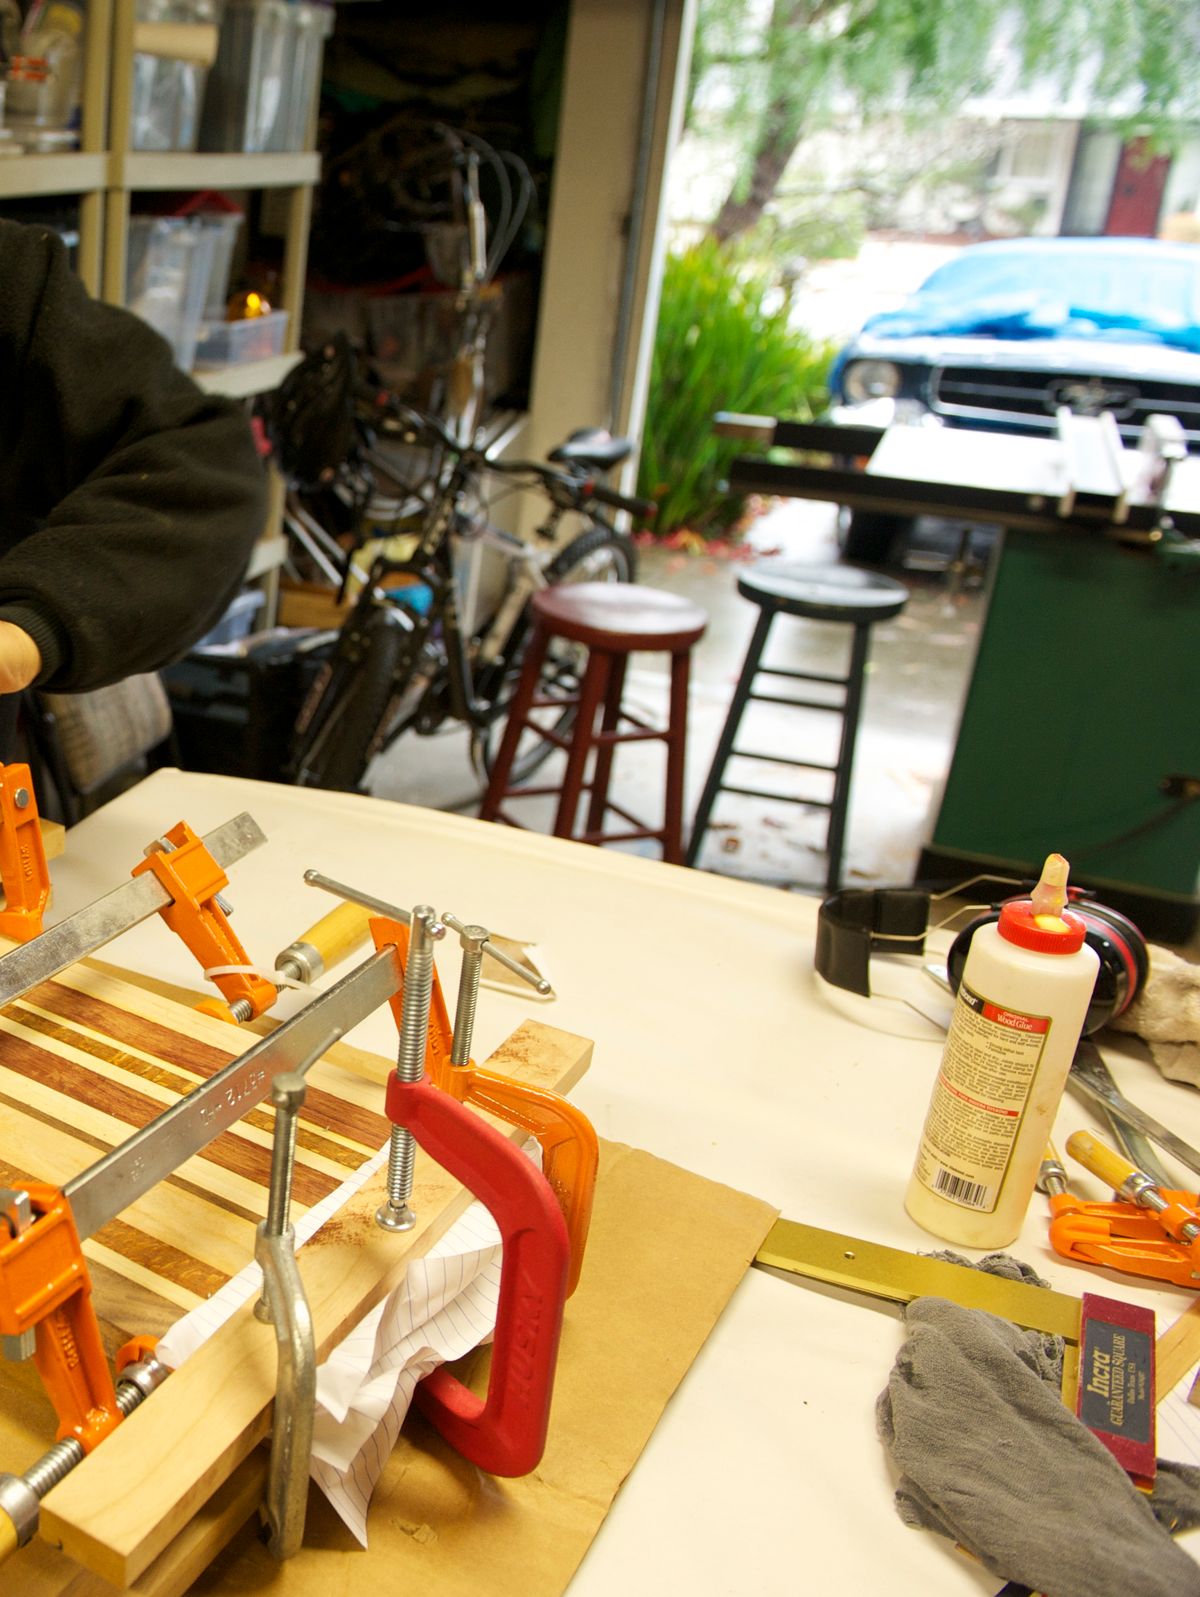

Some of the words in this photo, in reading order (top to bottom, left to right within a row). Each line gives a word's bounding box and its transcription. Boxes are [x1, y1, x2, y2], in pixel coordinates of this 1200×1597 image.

[997, 1014, 1016, 1027] Wood
[1015, 1020, 1032, 1030] Glue
[1112, 1333, 1127, 1367] SQUARE
[1087, 1349, 1110, 1399] Incra
[1110, 1367, 1124, 1426] GUARANTEED
